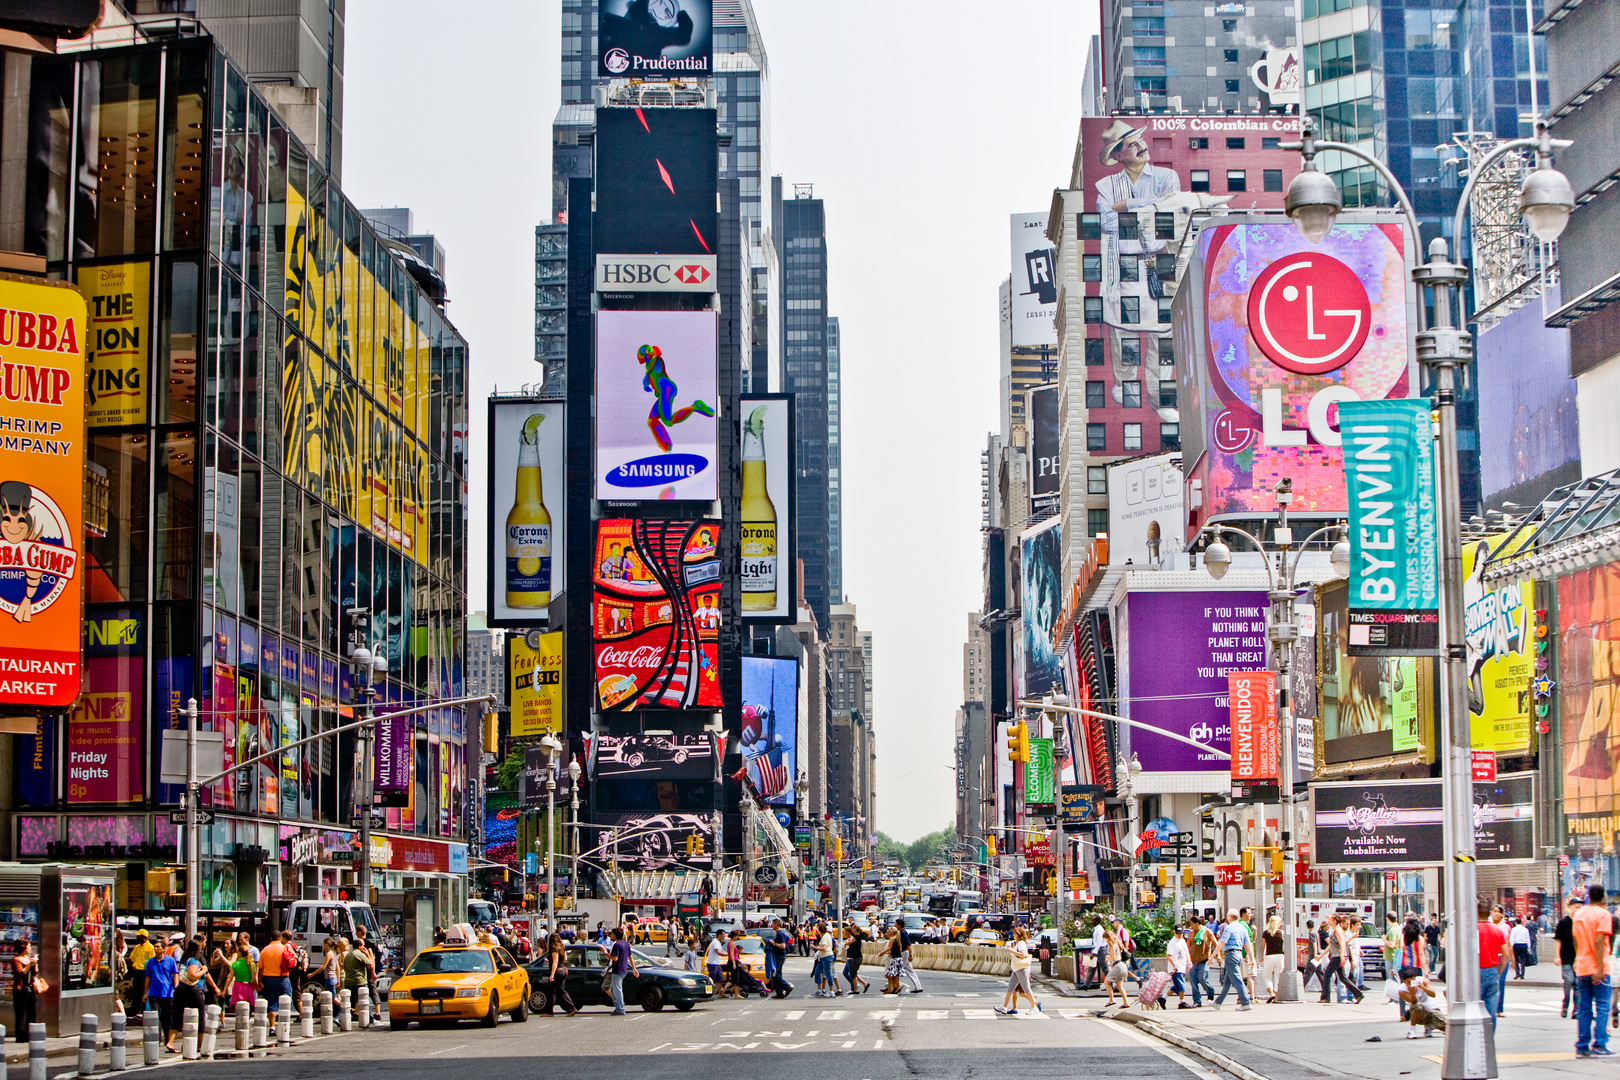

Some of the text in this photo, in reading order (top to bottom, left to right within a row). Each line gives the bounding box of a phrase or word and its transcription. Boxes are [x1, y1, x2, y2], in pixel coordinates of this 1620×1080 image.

[633, 55, 708, 70] Prudential
[1152, 119, 1319, 131] 100% Colombian Cofe
[602, 264, 671, 284] HSBC
[92, 292, 133, 317] THE
[0, 358, 70, 406] UMP
[0, 434, 72, 457] MPANY
[619, 464, 695, 478] SAMSUNG
[1415, 411, 1435, 600] CROSSROADS OF THE WORLD
[1133, 507, 1158, 518] PERFECTION
[1352, 425, 1396, 602] BYENVINI
[510, 526, 548, 539] Corona
[518, 537, 543, 545] Extra
[1405, 501, 1419, 600] TIMES SQUARE
[29, 544, 74, 575] GUMP
[1204, 607, 1212, 617] IF
[1214, 607, 1231, 617] YOU
[1235, 606, 1259, 617] THINK
[1350, 613, 1438, 624] TIMESSQUARENYC.ORG
[1212, 622, 1249, 633] NOTHING
[1208, 637, 1239, 648] PLANET
[1536, 609, 1548, 671] TOYS
[514, 653, 562, 670] Fearless
[1211, 652, 1263, 663] THAN GREAT
[1197, 668, 1215, 678] YOU
[517, 672, 559, 688] MUSIC
[1267, 678, 1275, 705] WORLD
[523, 700, 533, 708] LIVE
[87, 726, 111, 734] music
[1236, 679, 1253, 776] BIENVENIDOS
[1268, 722, 1275, 731] OF
[94, 735, 137, 746] premieres
[71, 752, 107, 765] Friday
[70, 767, 109, 781] Nights
[70, 783, 87, 798] 8p
[1344, 835, 1406, 845] Available Now
[1343, 846, 1407, 855] nbaballers.com
